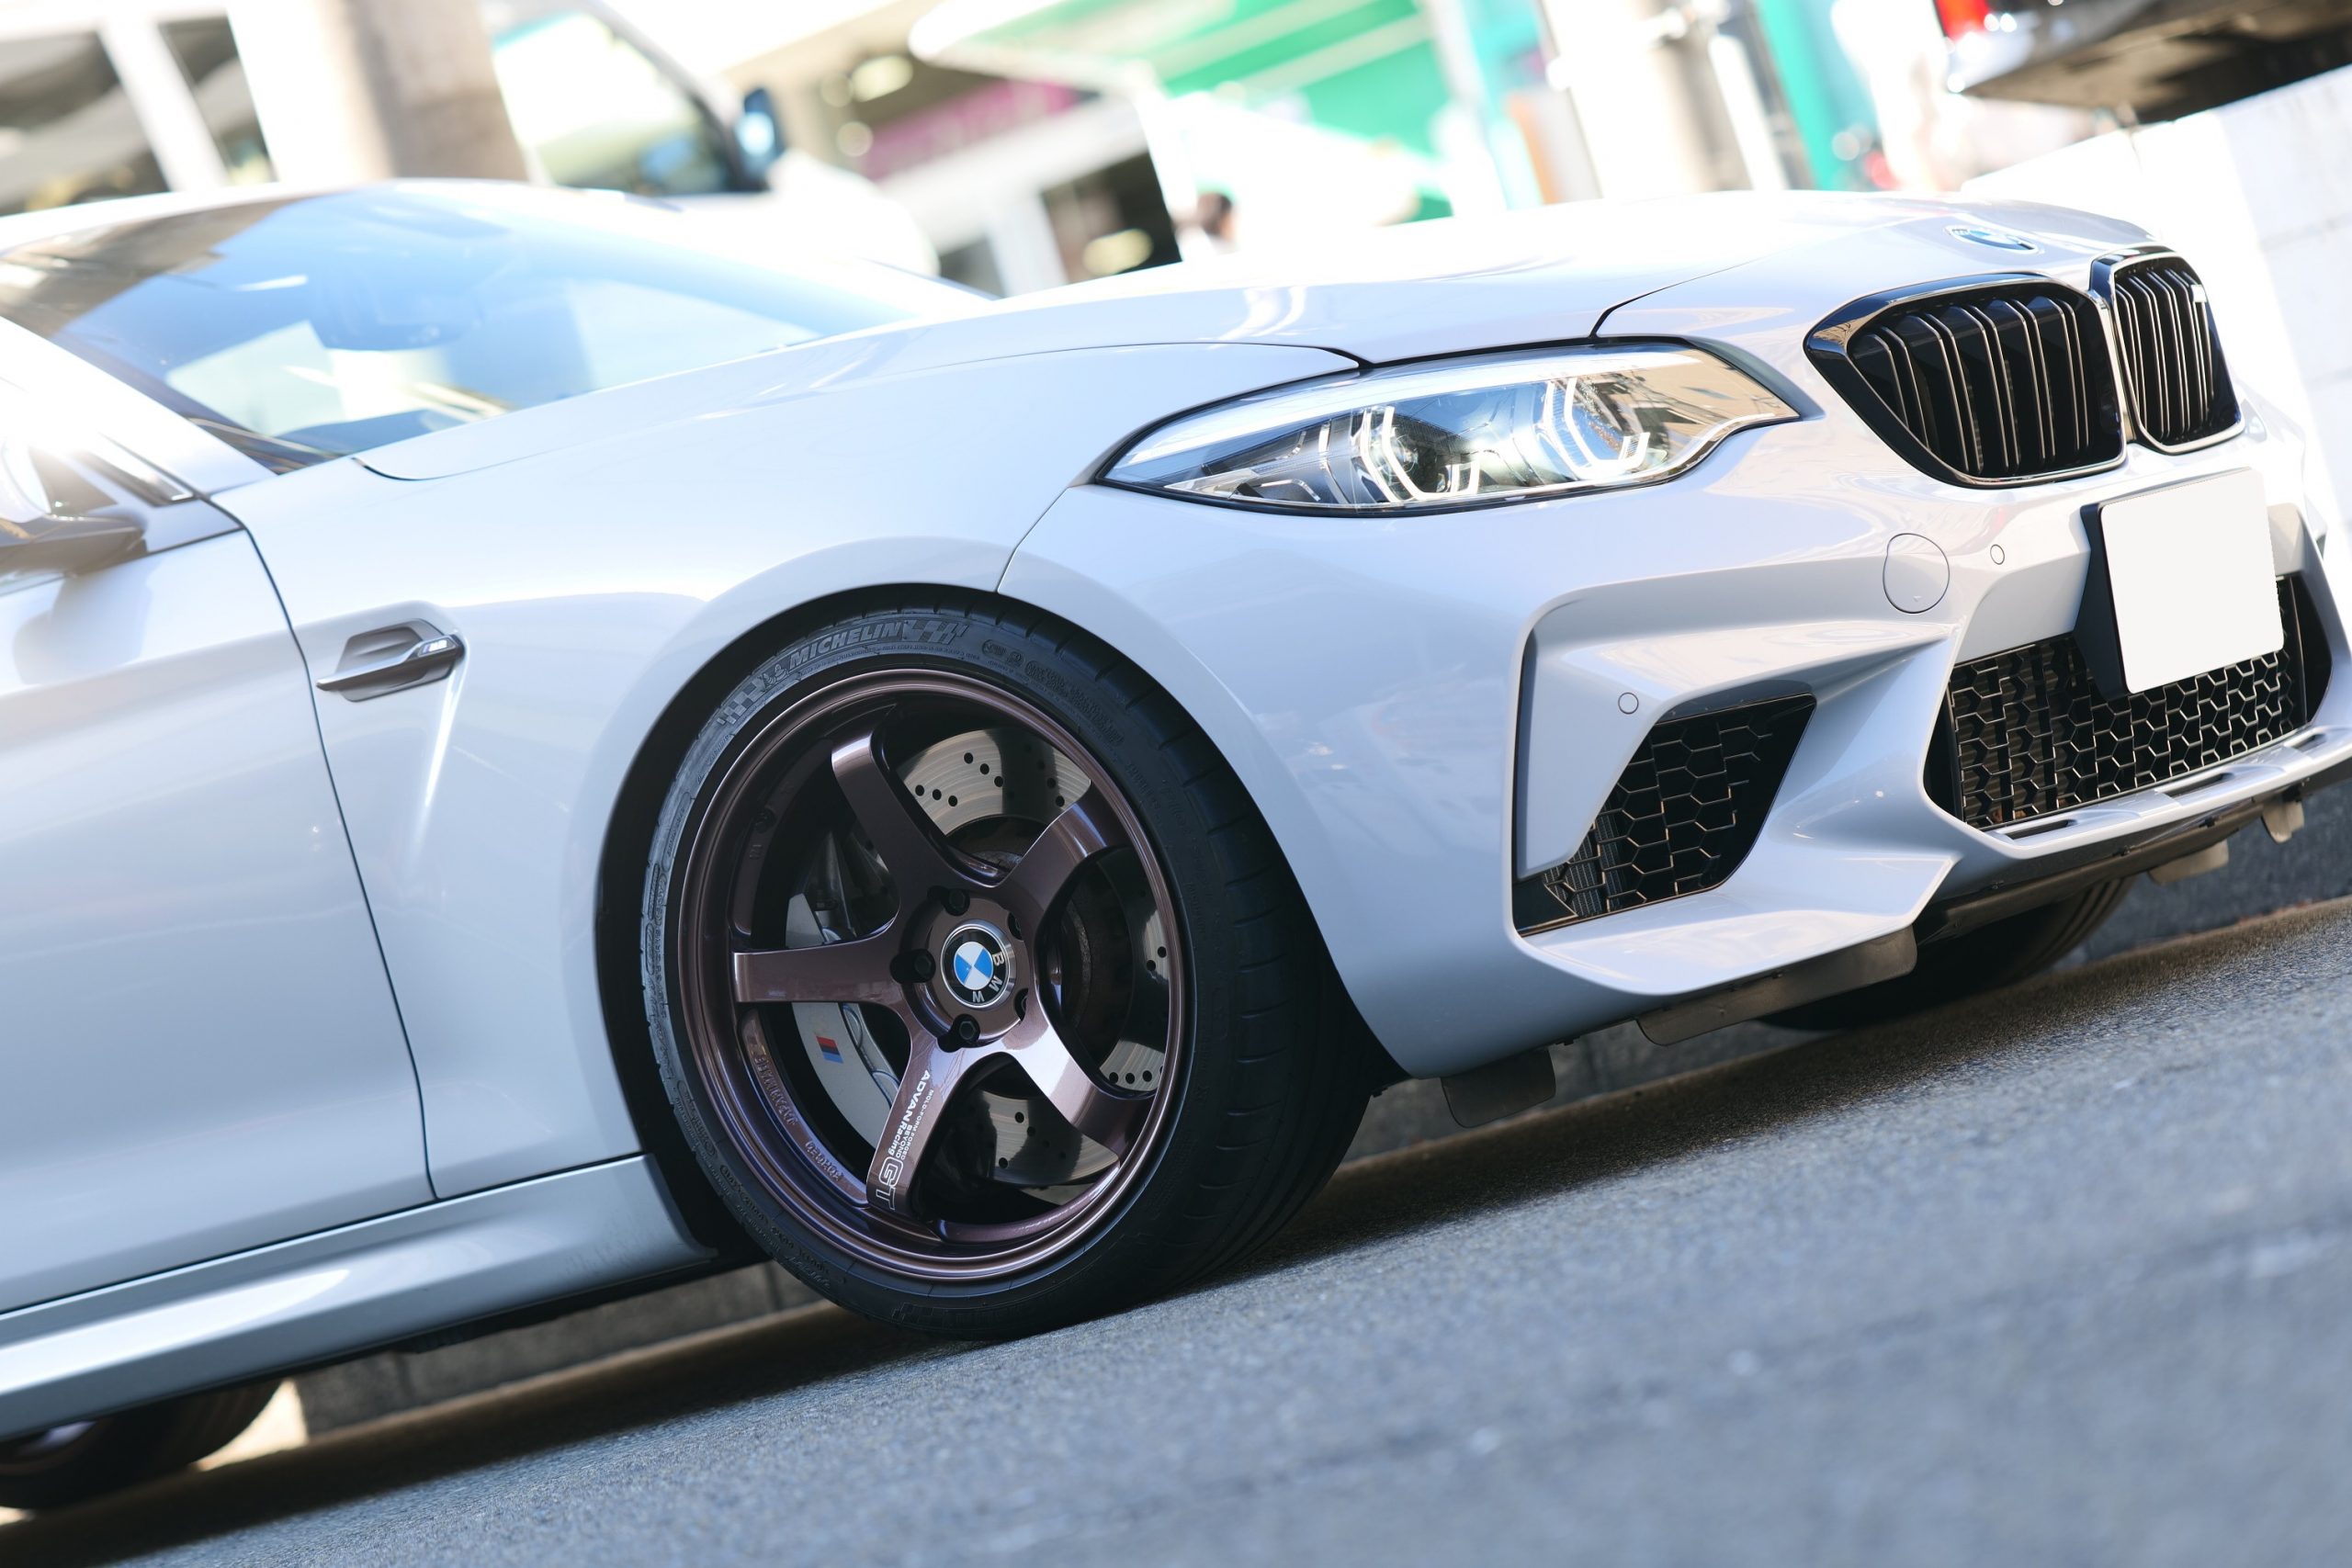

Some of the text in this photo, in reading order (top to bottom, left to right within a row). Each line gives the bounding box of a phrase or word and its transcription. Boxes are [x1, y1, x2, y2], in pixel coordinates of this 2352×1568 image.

[789, 622, 904, 669] MICHELIN
[971, 950, 1006, 1003] BMW
[888, 1069, 931, 1156] ADVAN Racing
[895, 1124, 914, 1158] BEYOND
[900, 1133, 915, 1161] FORGED
[876, 1156, 904, 1211] GT
